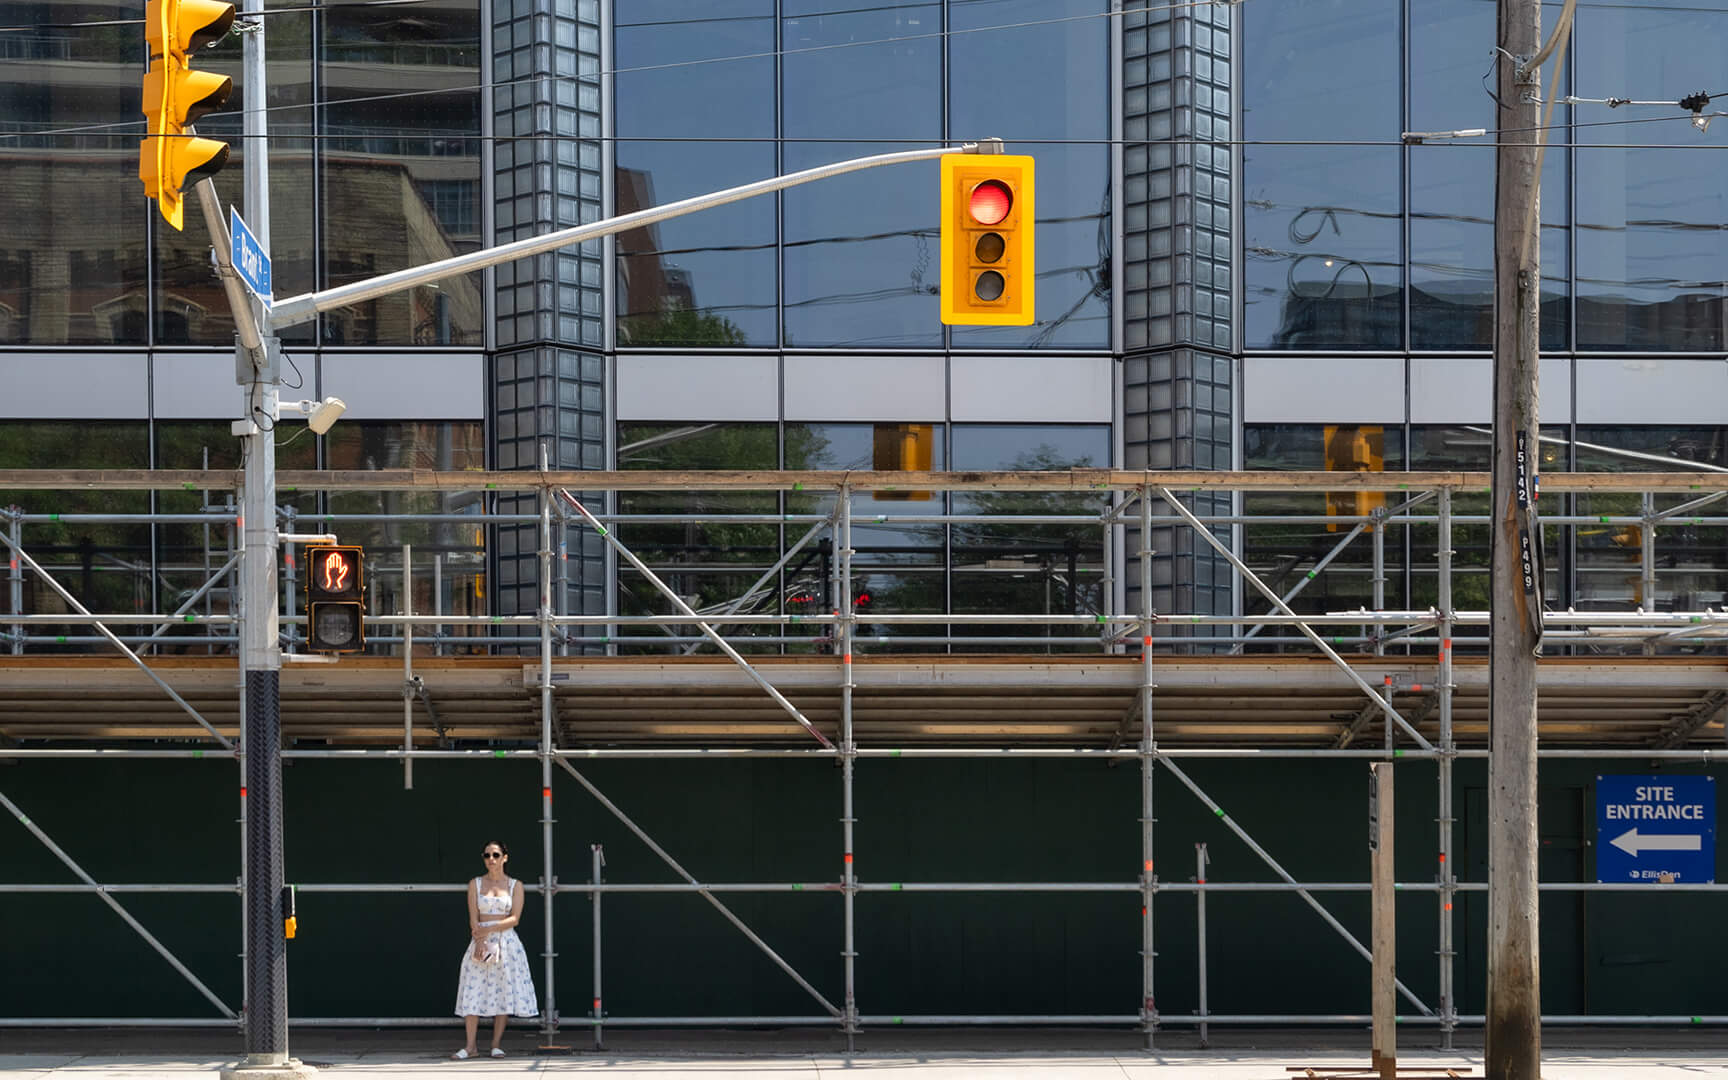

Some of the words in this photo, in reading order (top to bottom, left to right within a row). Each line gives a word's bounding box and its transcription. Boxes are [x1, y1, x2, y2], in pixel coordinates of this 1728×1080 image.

[1522, 537, 1532, 588] P499
[1635, 786, 1674, 802] SITE
[1606, 804, 1704, 820] ENTRANCE
